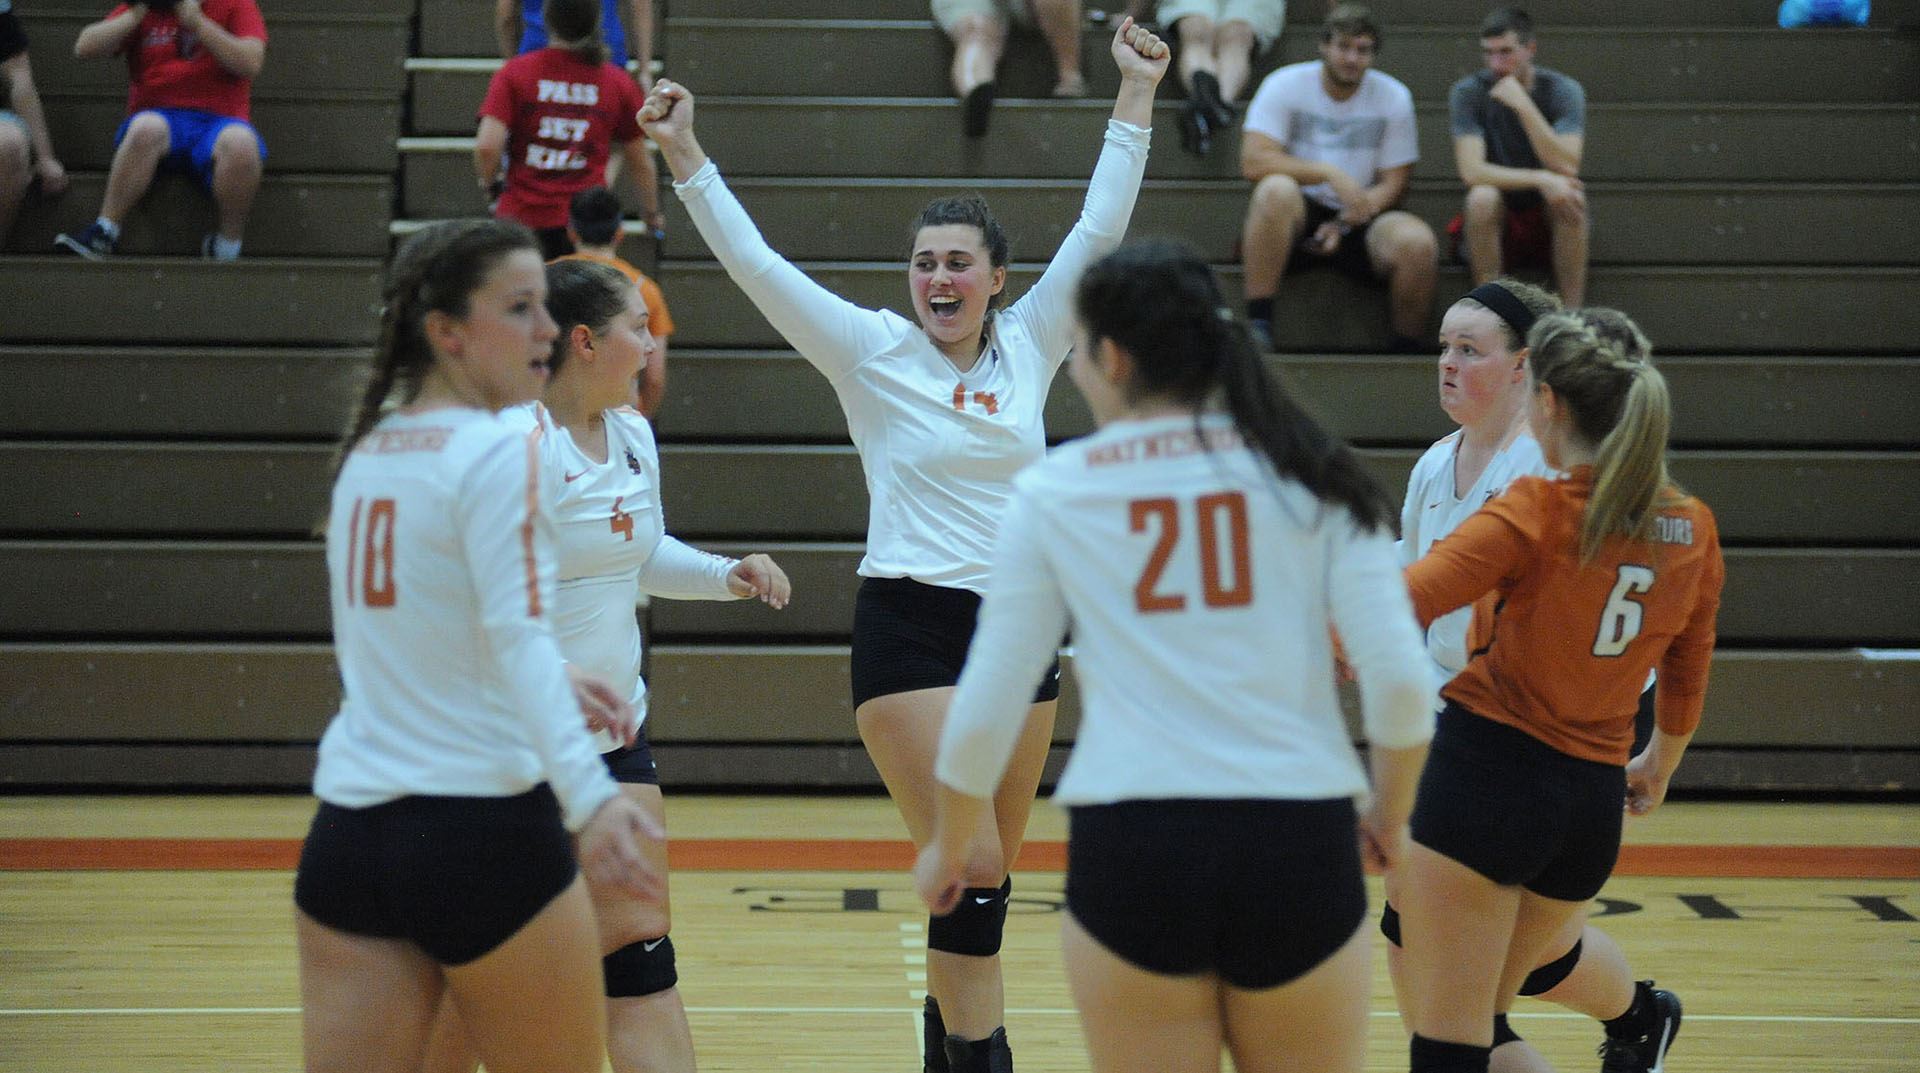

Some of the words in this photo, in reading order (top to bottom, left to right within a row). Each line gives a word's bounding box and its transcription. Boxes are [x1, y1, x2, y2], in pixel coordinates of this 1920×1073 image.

[537, 79, 599, 106] PASS
[537, 116, 590, 142] SET
[610, 496, 634, 542] 4
[1128, 491, 1254, 614] 20
[1591, 562, 1656, 659] 6
